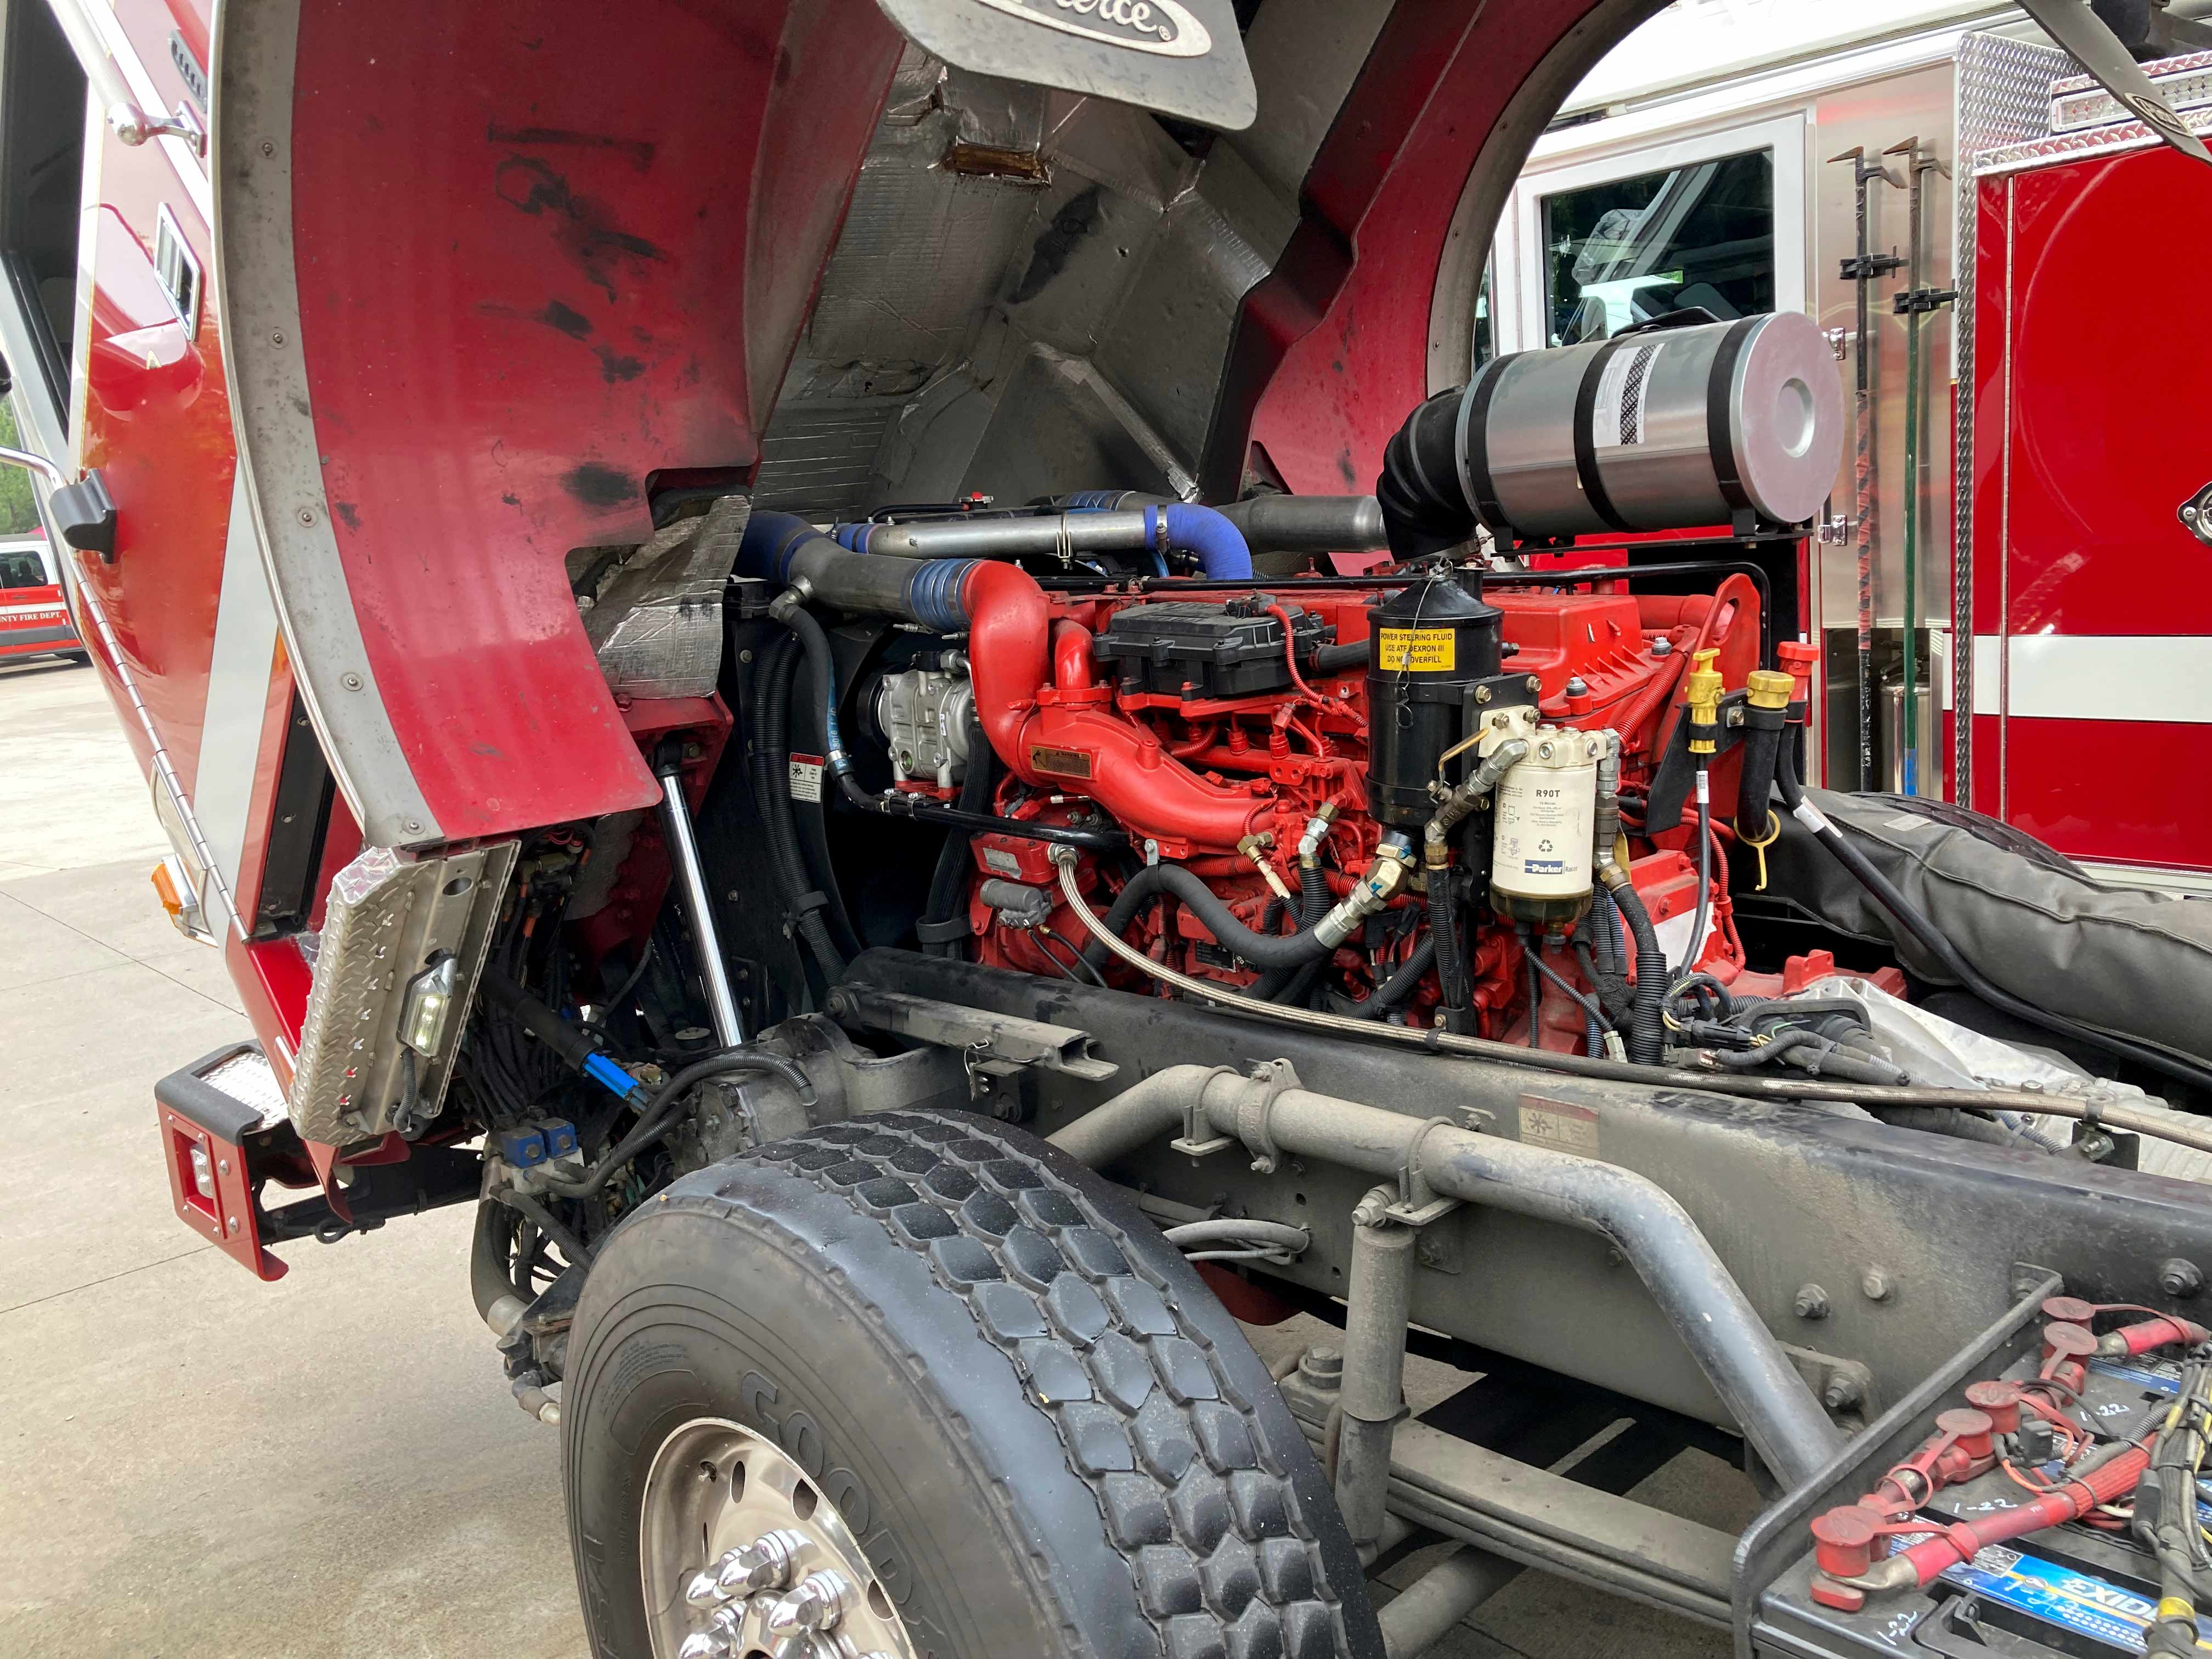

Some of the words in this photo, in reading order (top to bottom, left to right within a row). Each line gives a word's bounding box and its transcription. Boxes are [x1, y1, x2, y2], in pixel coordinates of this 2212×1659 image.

[40, 611, 62, 619] DEPT.
[1536, 789, 1560, 798] R90T
[1532, 864, 1562, 873] Parker
[1953, 1498, 2019, 1514] 1-22
[2061, 1578, 2158, 1622] EXID
[1876, 1610, 1918, 1646] 1-22
